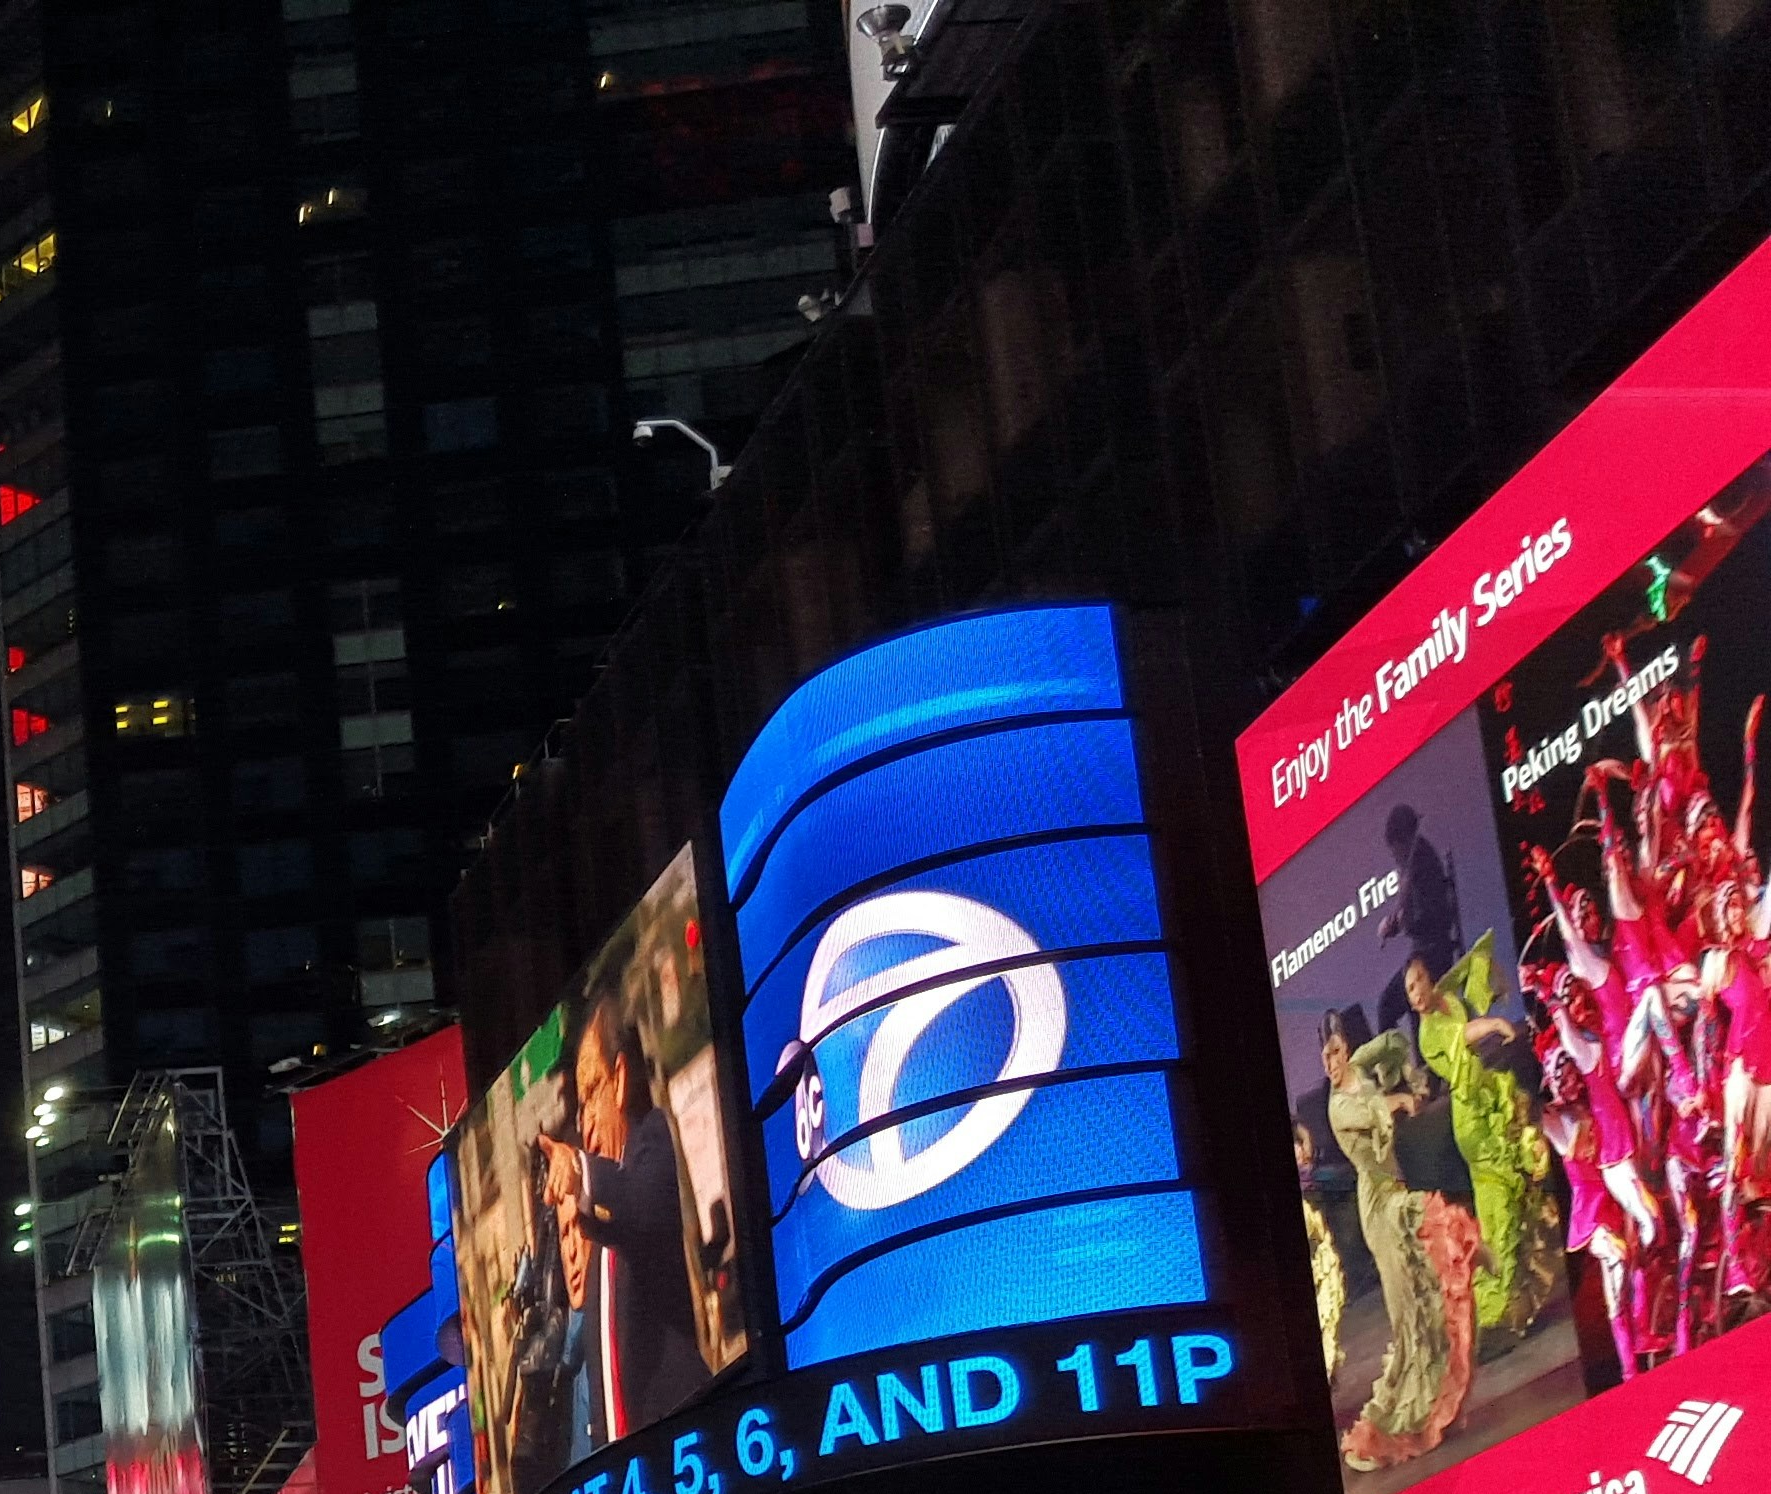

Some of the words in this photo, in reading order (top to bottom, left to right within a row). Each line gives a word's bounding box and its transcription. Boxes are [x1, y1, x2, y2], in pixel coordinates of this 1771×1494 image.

[1271, 726, 1330, 807] Enjoy
[1335, 683, 1372, 749] the
[1376, 603, 1468, 713] Family
[1472, 516, 1571, 625] Series
[1502, 716, 1583, 802] Peking
[1583, 643, 1678, 735] Dreams
[1271, 901, 1355, 988] Flamenco
[1360, 869, 1399, 915] Fire
[736, 1409, 793, 1480] 6,
[819, 1355, 1022, 1454] AND
[1058, 1334, 1234, 1413] 11P
